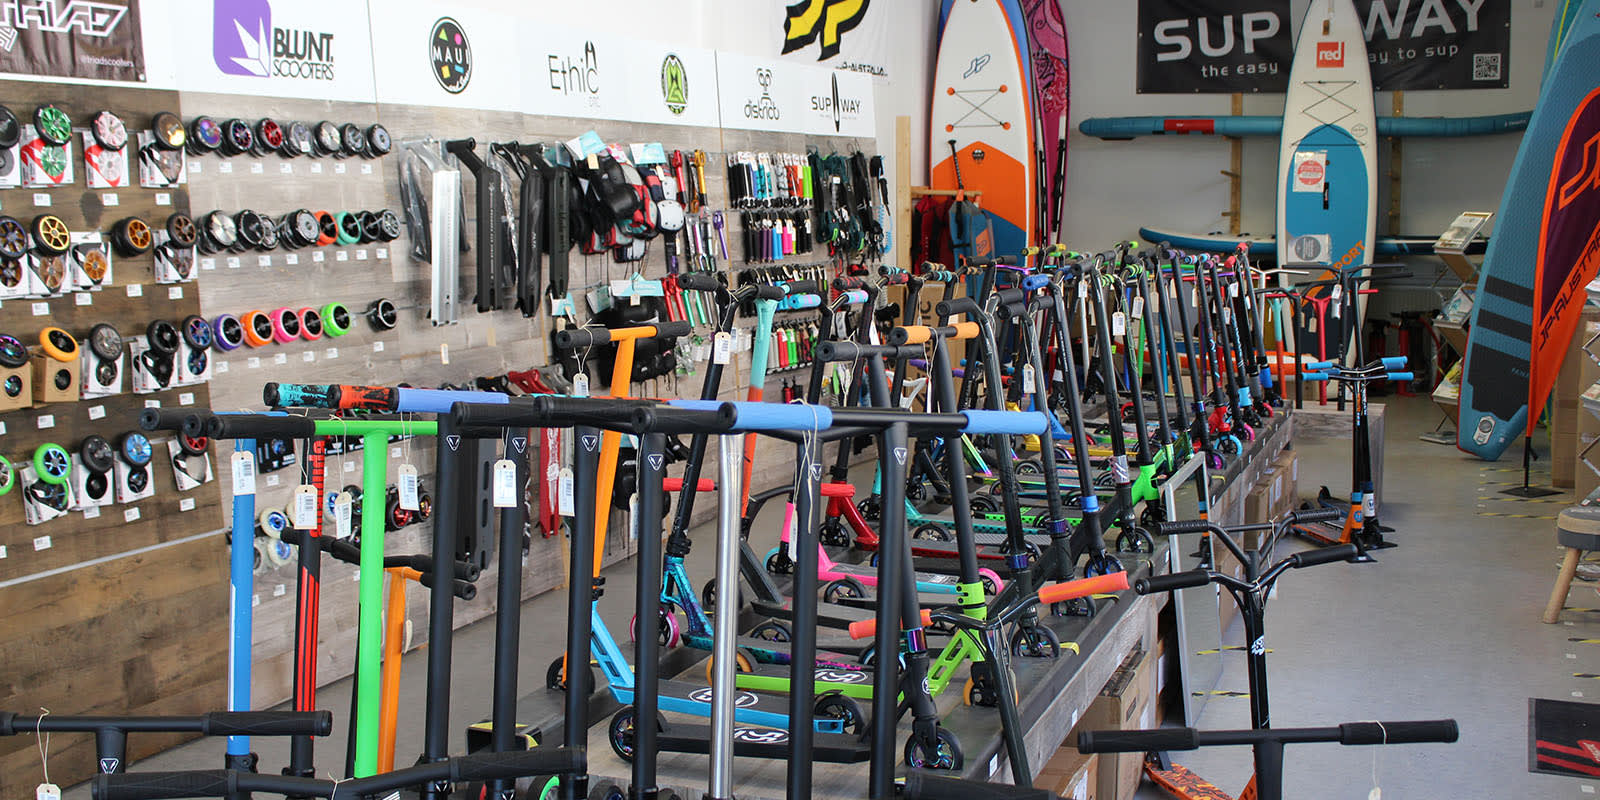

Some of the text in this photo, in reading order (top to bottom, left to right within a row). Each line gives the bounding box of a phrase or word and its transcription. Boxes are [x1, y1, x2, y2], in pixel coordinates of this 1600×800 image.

[1154, 0, 1485, 62] SUP WAY
[433, 45, 469, 65] MAUI
[1201, 44, 1459, 78] the easy ay to sup
[1319, 41, 1342, 60] red
[273, 59, 334, 81] SCOOTERS
[548, 54, 599, 95] Ethic
[811, 96, 861, 113] SUP WAY
[1330, 240, 1365, 275] PORT
